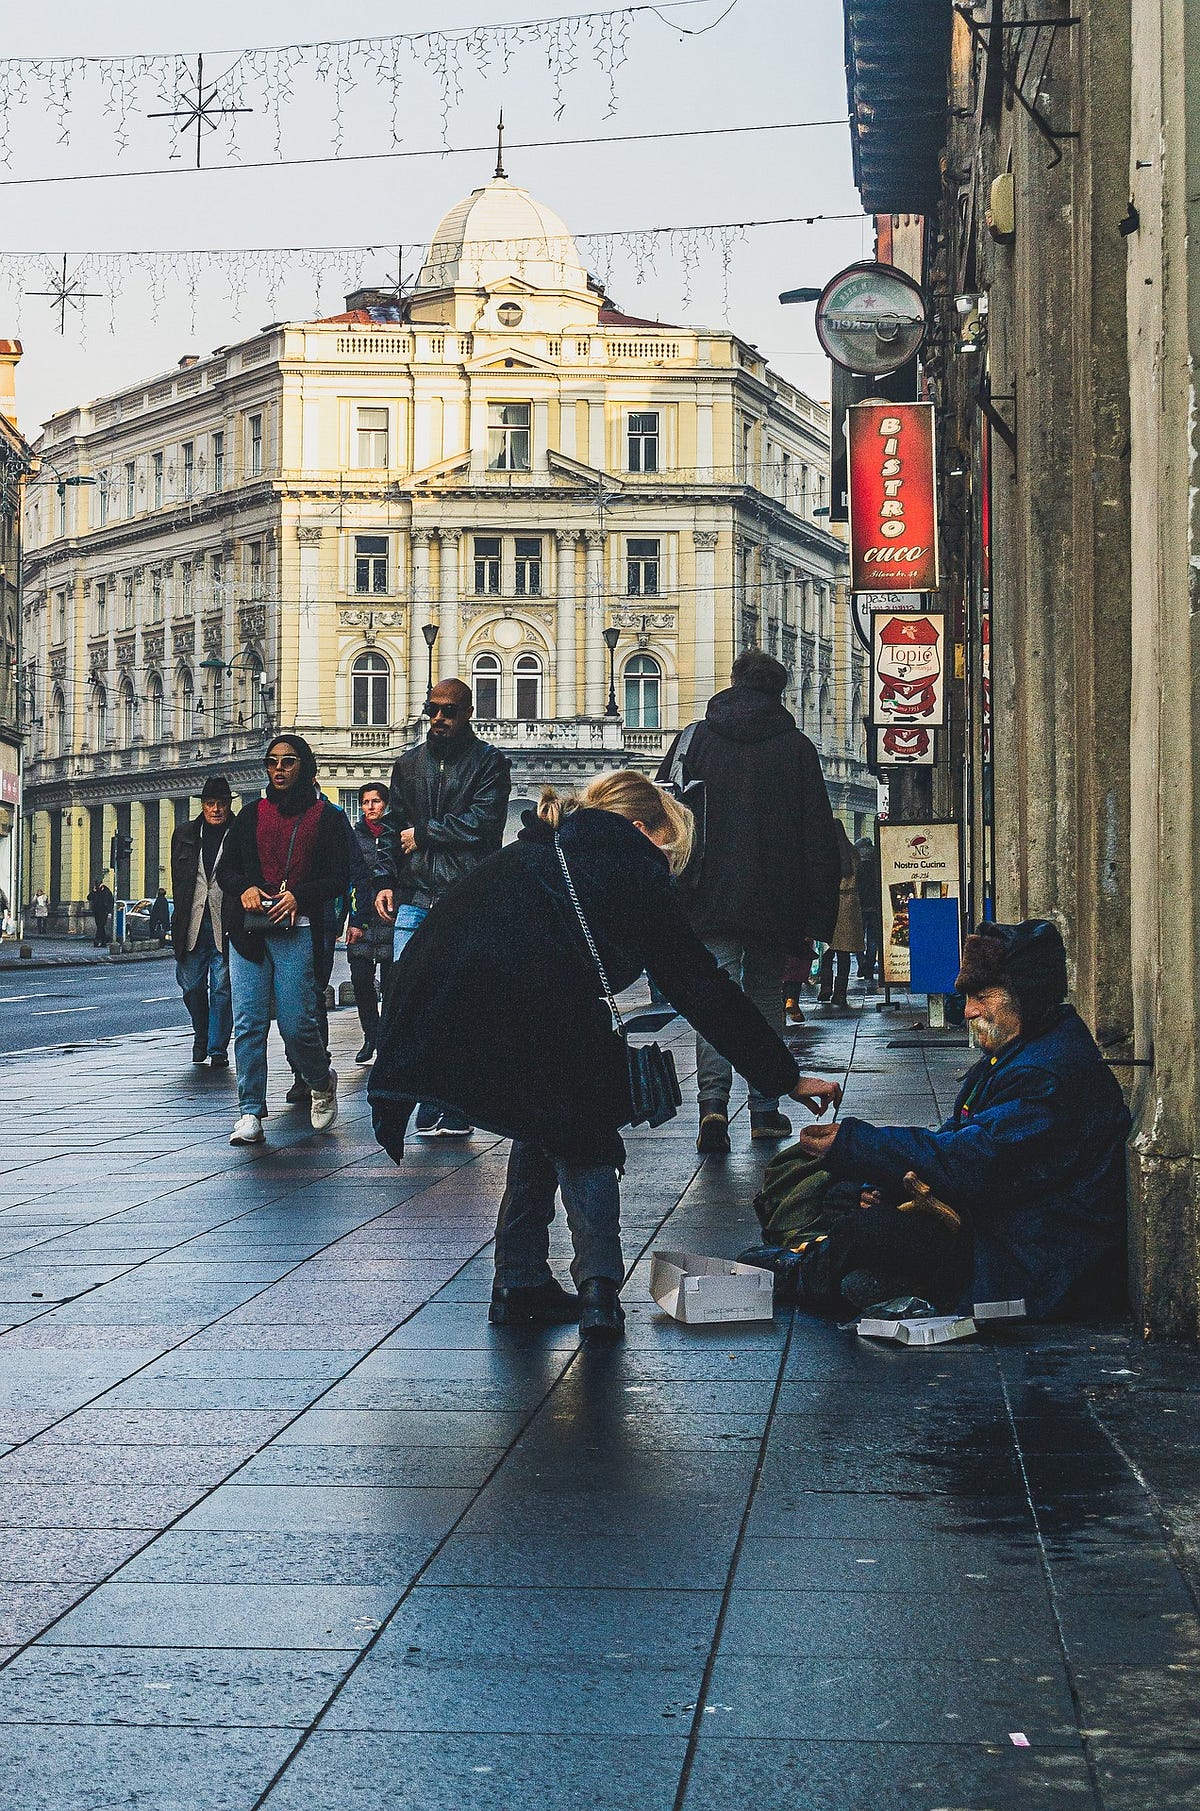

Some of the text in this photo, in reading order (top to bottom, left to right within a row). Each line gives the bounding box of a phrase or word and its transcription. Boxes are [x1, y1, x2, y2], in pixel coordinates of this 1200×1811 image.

[880, 417, 906, 538] BISTRO
[863, 546, 928, 563] cuco
[920, 860, 946, 869] Cucina
